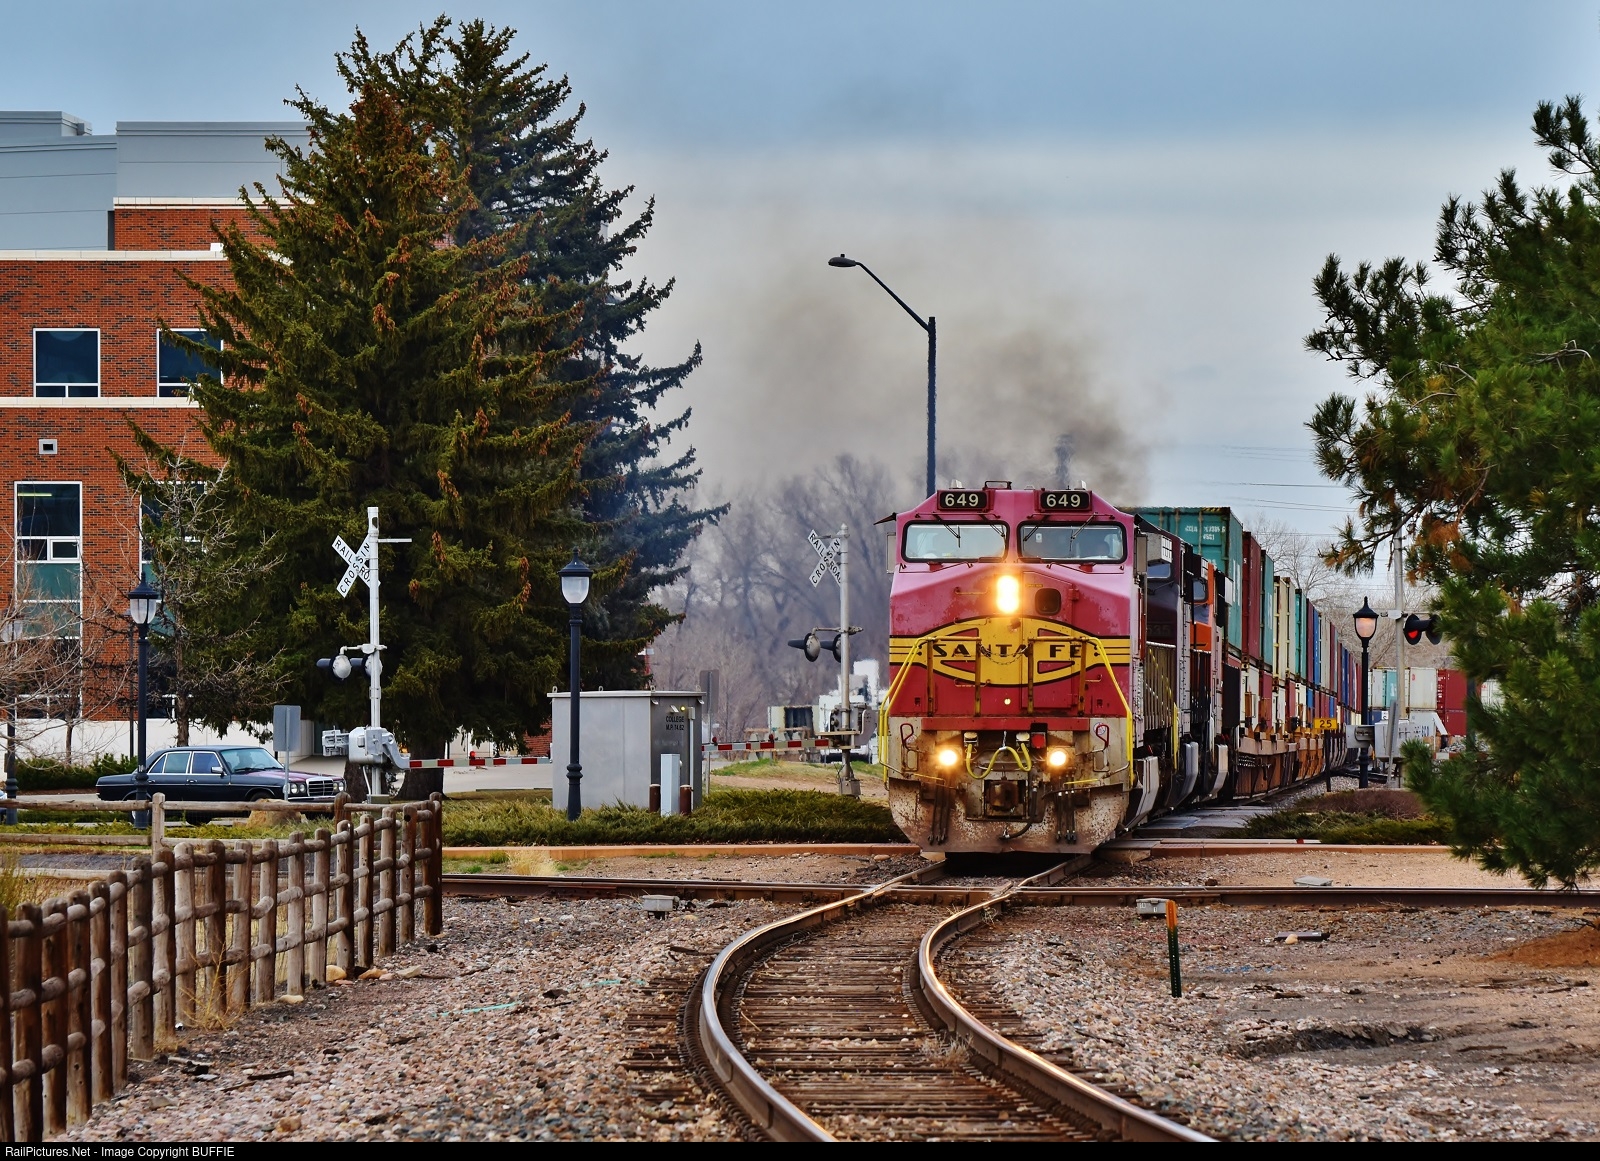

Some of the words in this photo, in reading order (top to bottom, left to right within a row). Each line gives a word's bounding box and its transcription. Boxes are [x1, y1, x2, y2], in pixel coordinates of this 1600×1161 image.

[944, 493, 979, 507] 649
[1046, 493, 1081, 507] 649
[340, 542, 371, 594] CROSSIN
[811, 539, 841, 585] CROSSIN
[1049, 644, 1082, 658] FE
[1319, 719, 1332, 728] 25
